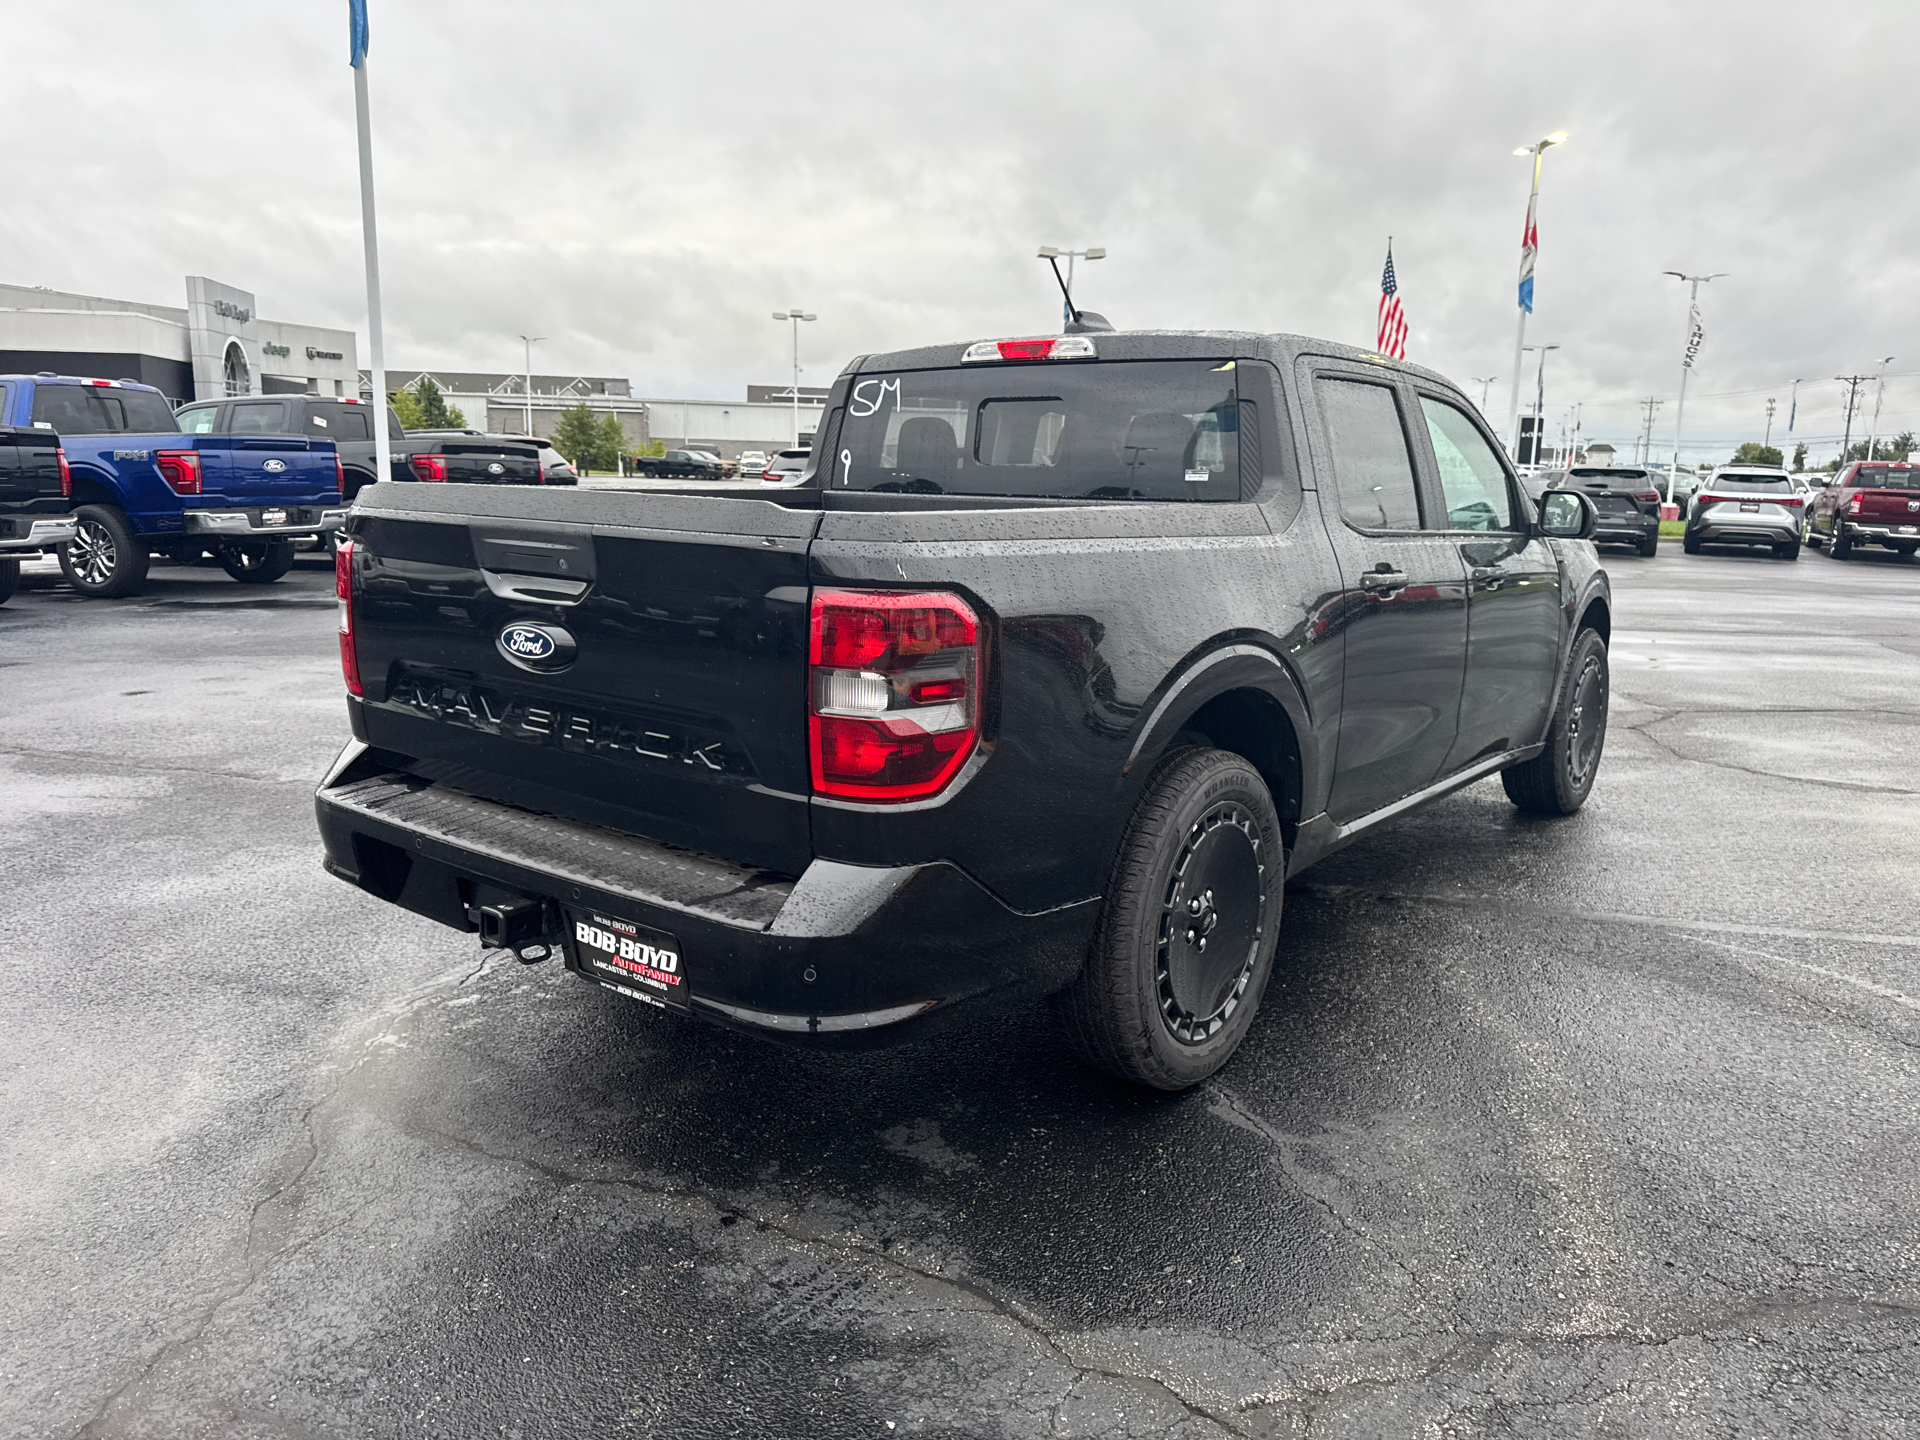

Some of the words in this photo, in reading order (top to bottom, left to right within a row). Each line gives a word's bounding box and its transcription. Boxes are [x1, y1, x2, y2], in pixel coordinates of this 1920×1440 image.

[262, 341, 291, 358] Jeep
[114, 450, 149, 462] FX4
[840, 449, 852, 486] 9
[510, 629, 544, 655] Ford
[408, 681, 724, 771] MAVERICK
[1203, 775, 1250, 800] WRANGLER
[592, 958, 629, 978] LANCASTER
[633, 972, 668, 991] COLUMBUS
